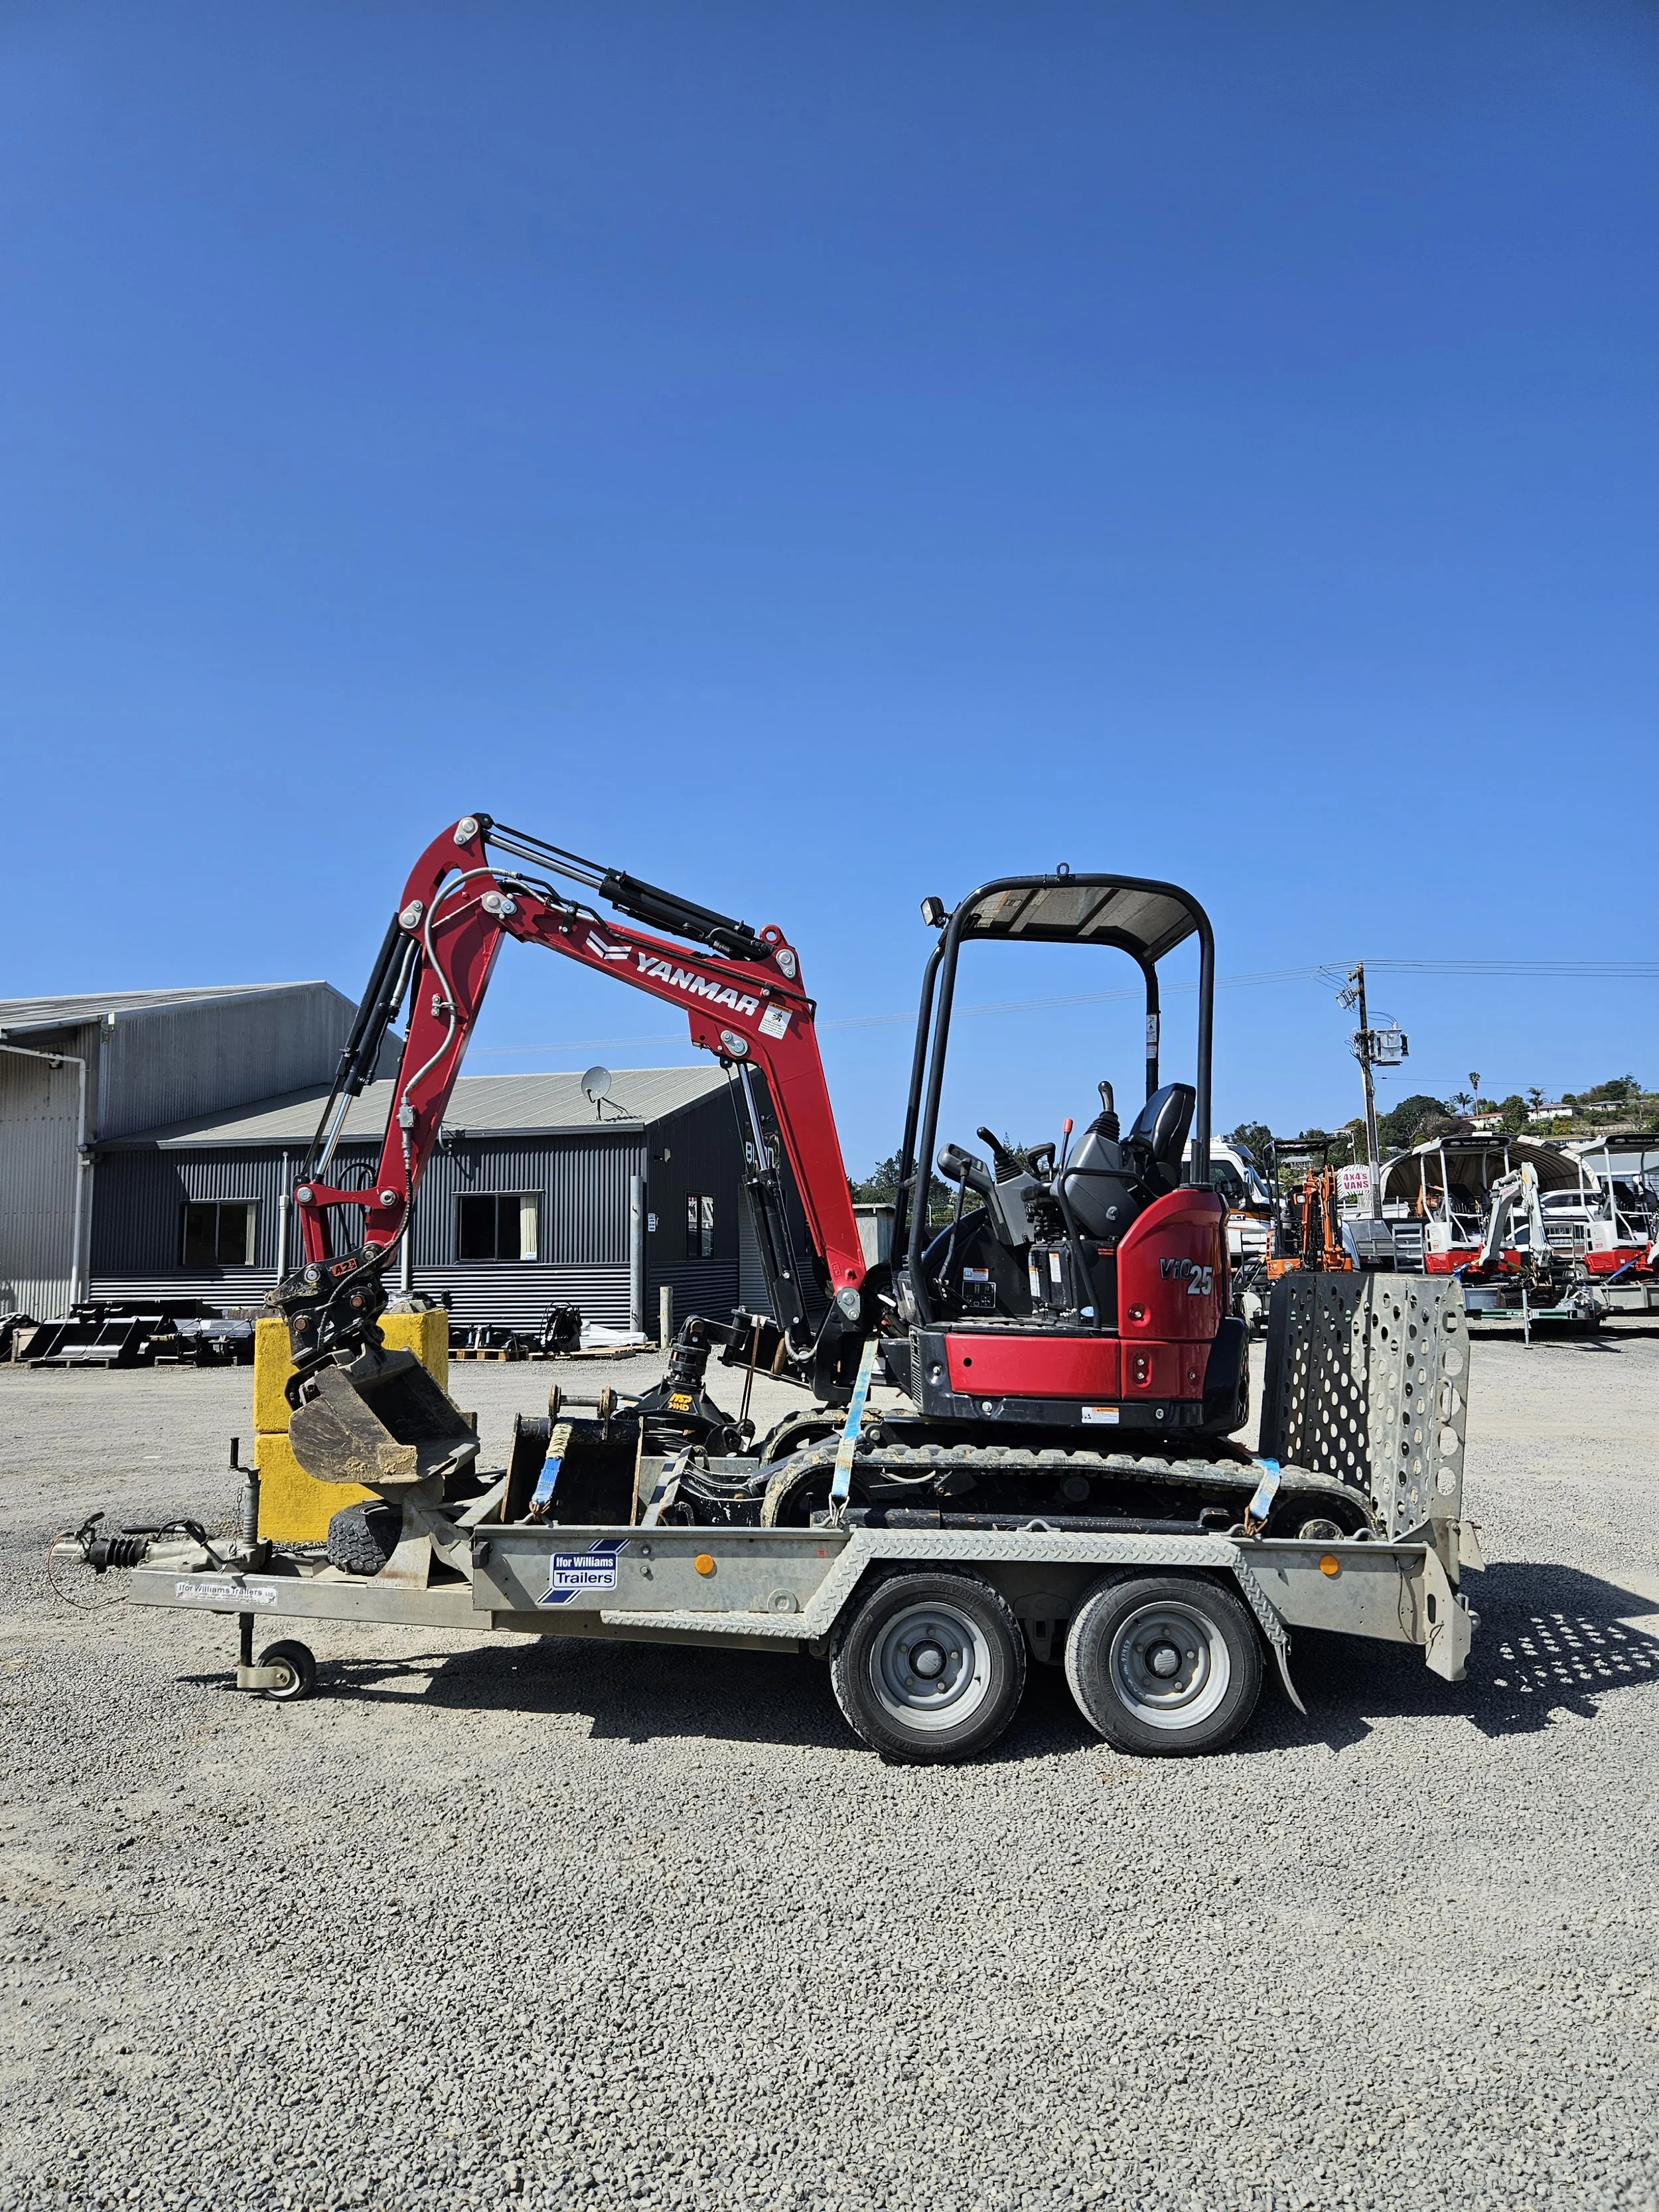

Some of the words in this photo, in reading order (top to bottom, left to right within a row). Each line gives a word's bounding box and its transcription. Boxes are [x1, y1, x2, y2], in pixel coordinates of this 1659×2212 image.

[637, 952, 759, 1016] YANMAR
[1344, 1181, 1369, 1189] VANS
[1187, 1265, 1213, 1295] 25
[668, 1402, 689, 1412] HHD
[556, 1556, 572, 1567] Ifor
[573, 1556, 614, 1567] Williams
[556, 1572, 613, 1584] Trailers
[195, 1585, 230, 1593] Williams
[232, 1587, 263, 1596] Trailers
